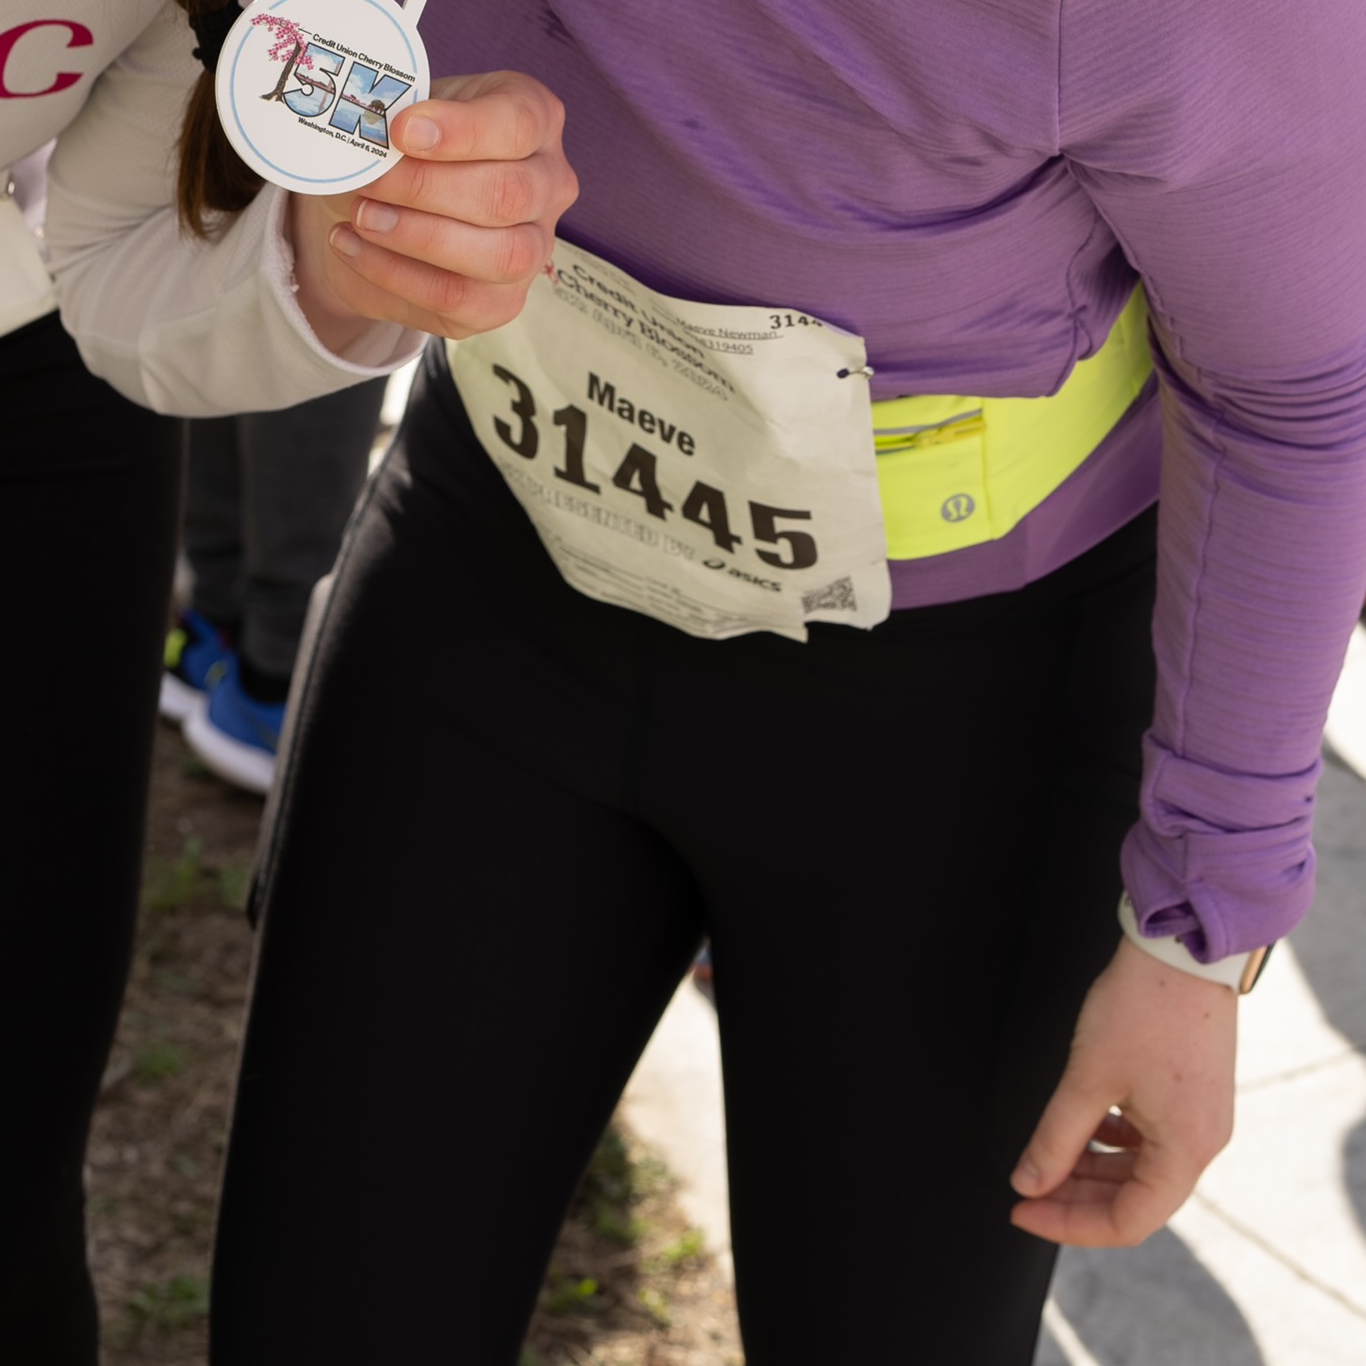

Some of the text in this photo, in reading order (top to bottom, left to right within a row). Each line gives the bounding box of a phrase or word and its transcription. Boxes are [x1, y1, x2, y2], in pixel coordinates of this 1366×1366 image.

[283, 42, 412, 149] 5K
[312, 33, 416, 82] Credit Union Cherry Blossom
[298, 117, 334, 138] Washington,
[335, 132, 347, 143] D.C.
[350, 138, 366, 150] April
[371, 147, 388, 159] 2024
[557, 268, 634, 328] Cherry
[637, 318, 737, 394] Blossom
[572, 264, 637, 313] Credit
[586, 370, 697, 458] Maeve
[491, 363, 819, 571] 31445
